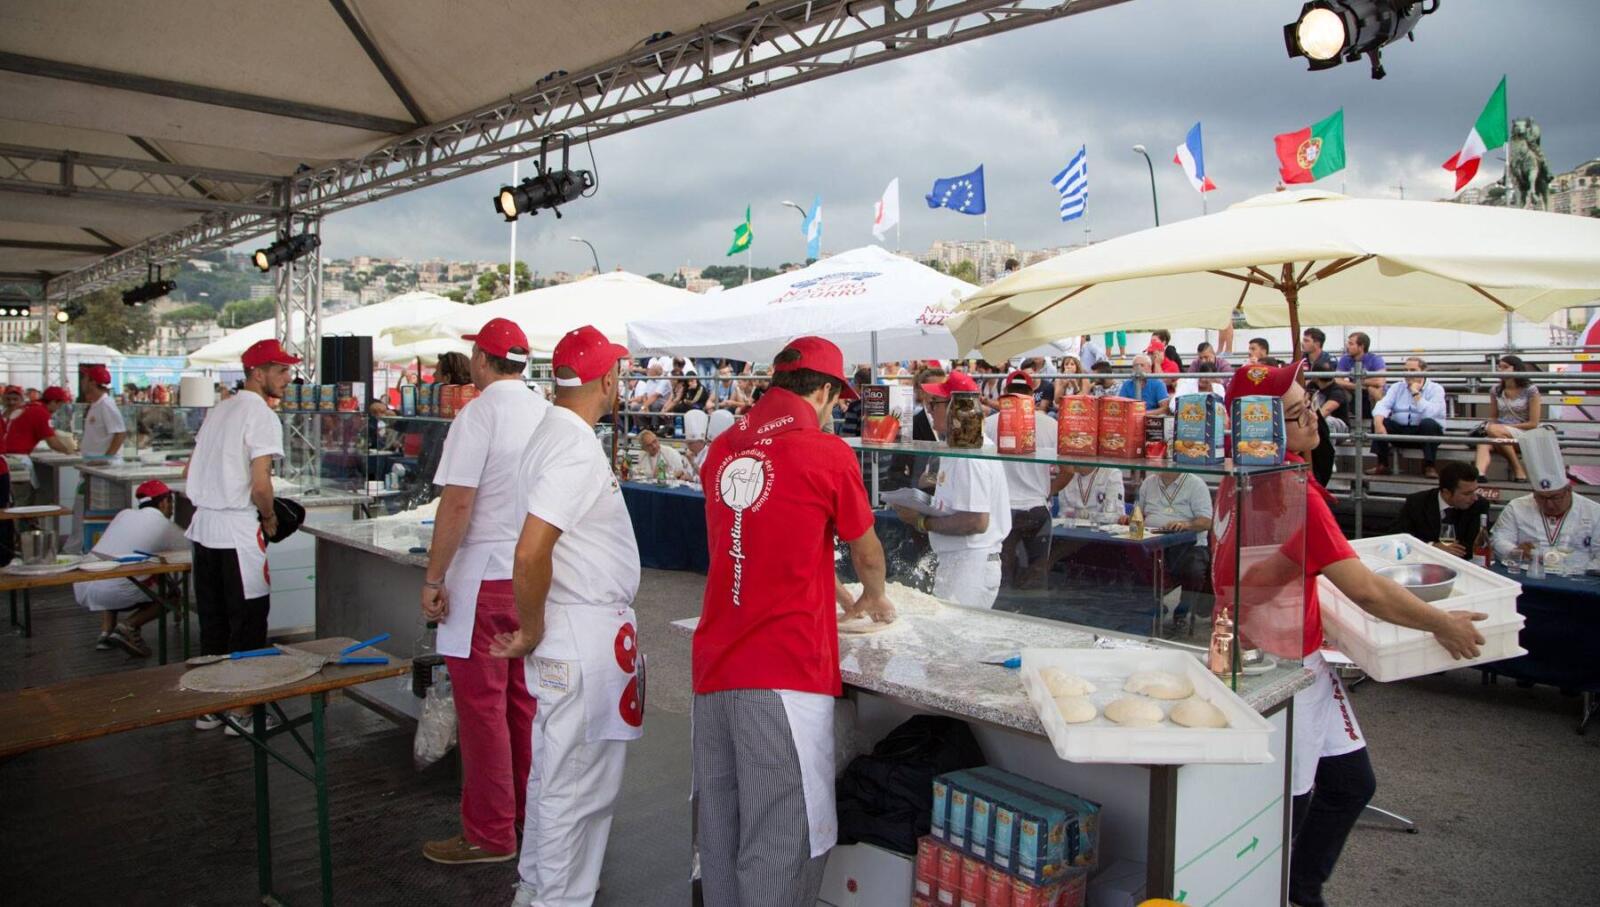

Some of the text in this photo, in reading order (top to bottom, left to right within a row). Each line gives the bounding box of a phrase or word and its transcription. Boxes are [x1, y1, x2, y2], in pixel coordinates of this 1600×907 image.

[916, 313, 949, 326] AZZ
[757, 416, 794, 434] CAPUTO
[729, 507, 746, 606] pizza-festival
